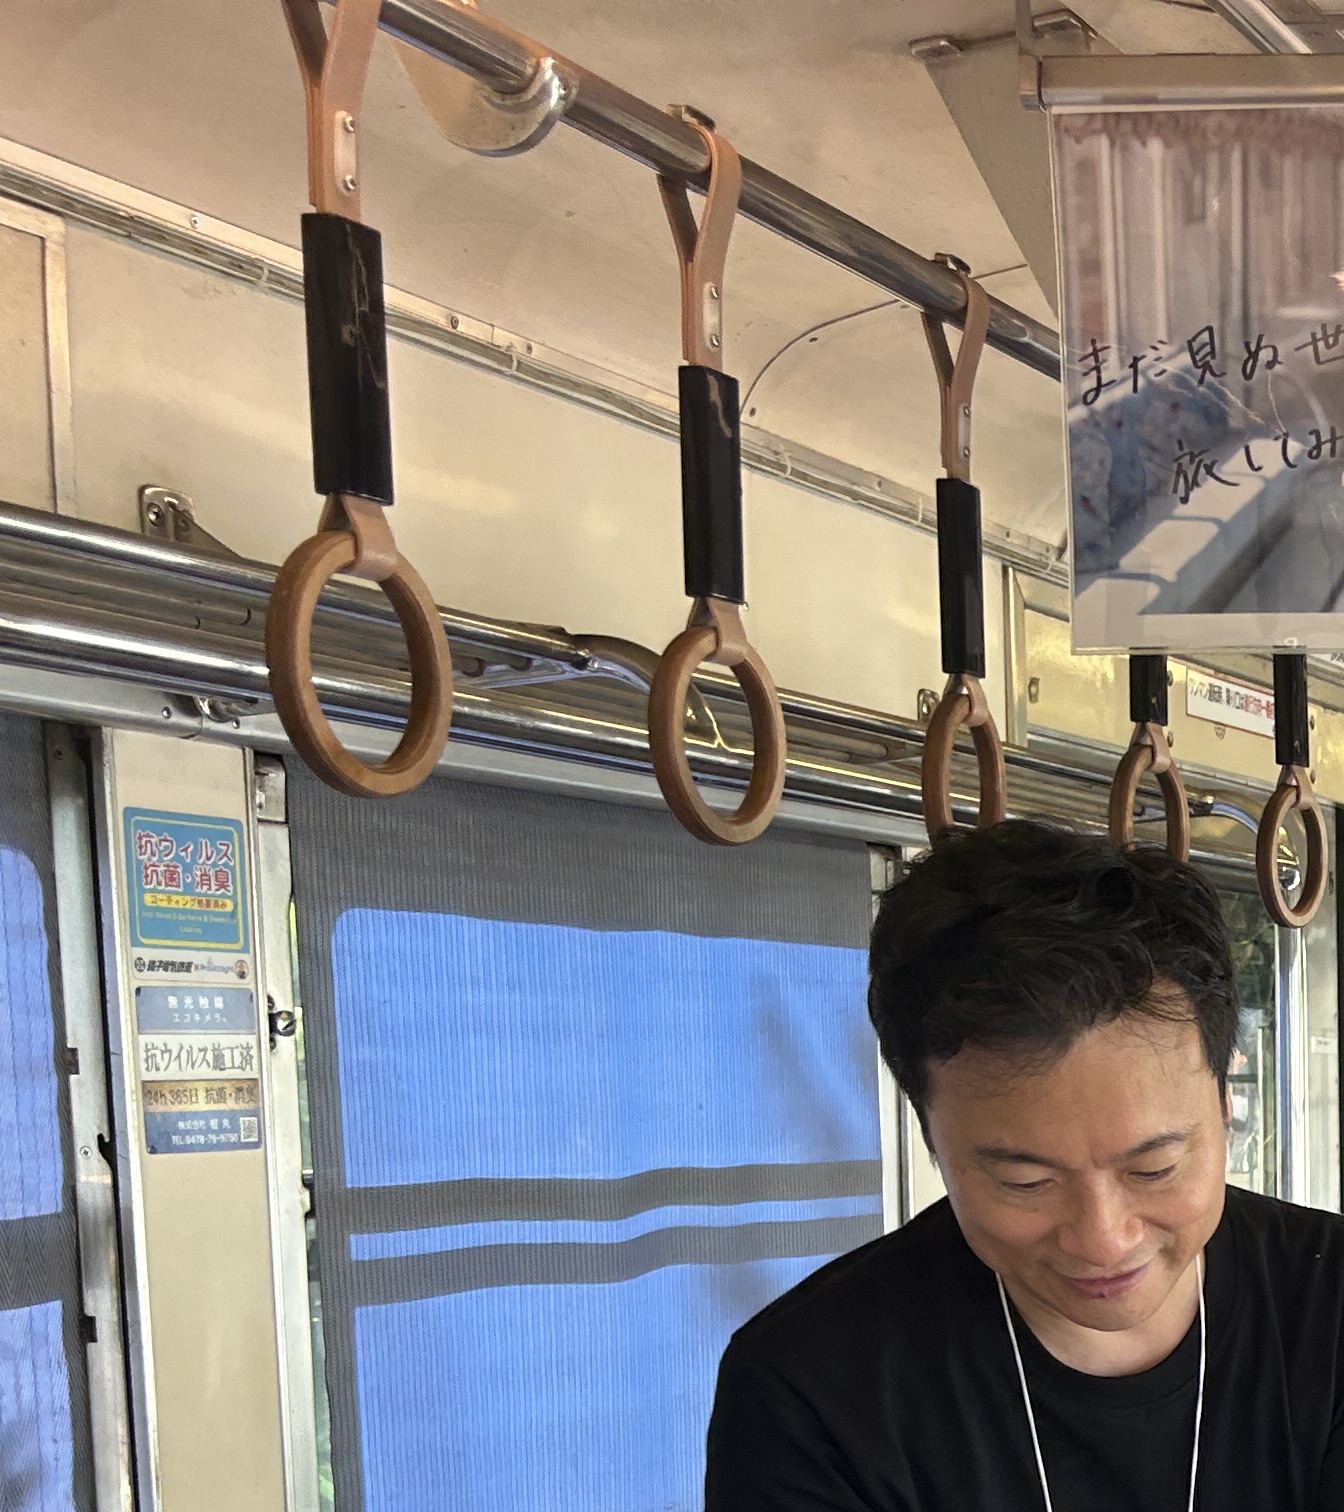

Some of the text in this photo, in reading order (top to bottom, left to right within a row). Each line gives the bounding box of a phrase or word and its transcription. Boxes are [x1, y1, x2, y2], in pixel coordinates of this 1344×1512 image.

[136, 830, 236, 866] 抗ウィルス
[142, 861, 234, 895] 抗菌・消臭
[143, 1041, 255, 1073] 抗ウイルス施工済
